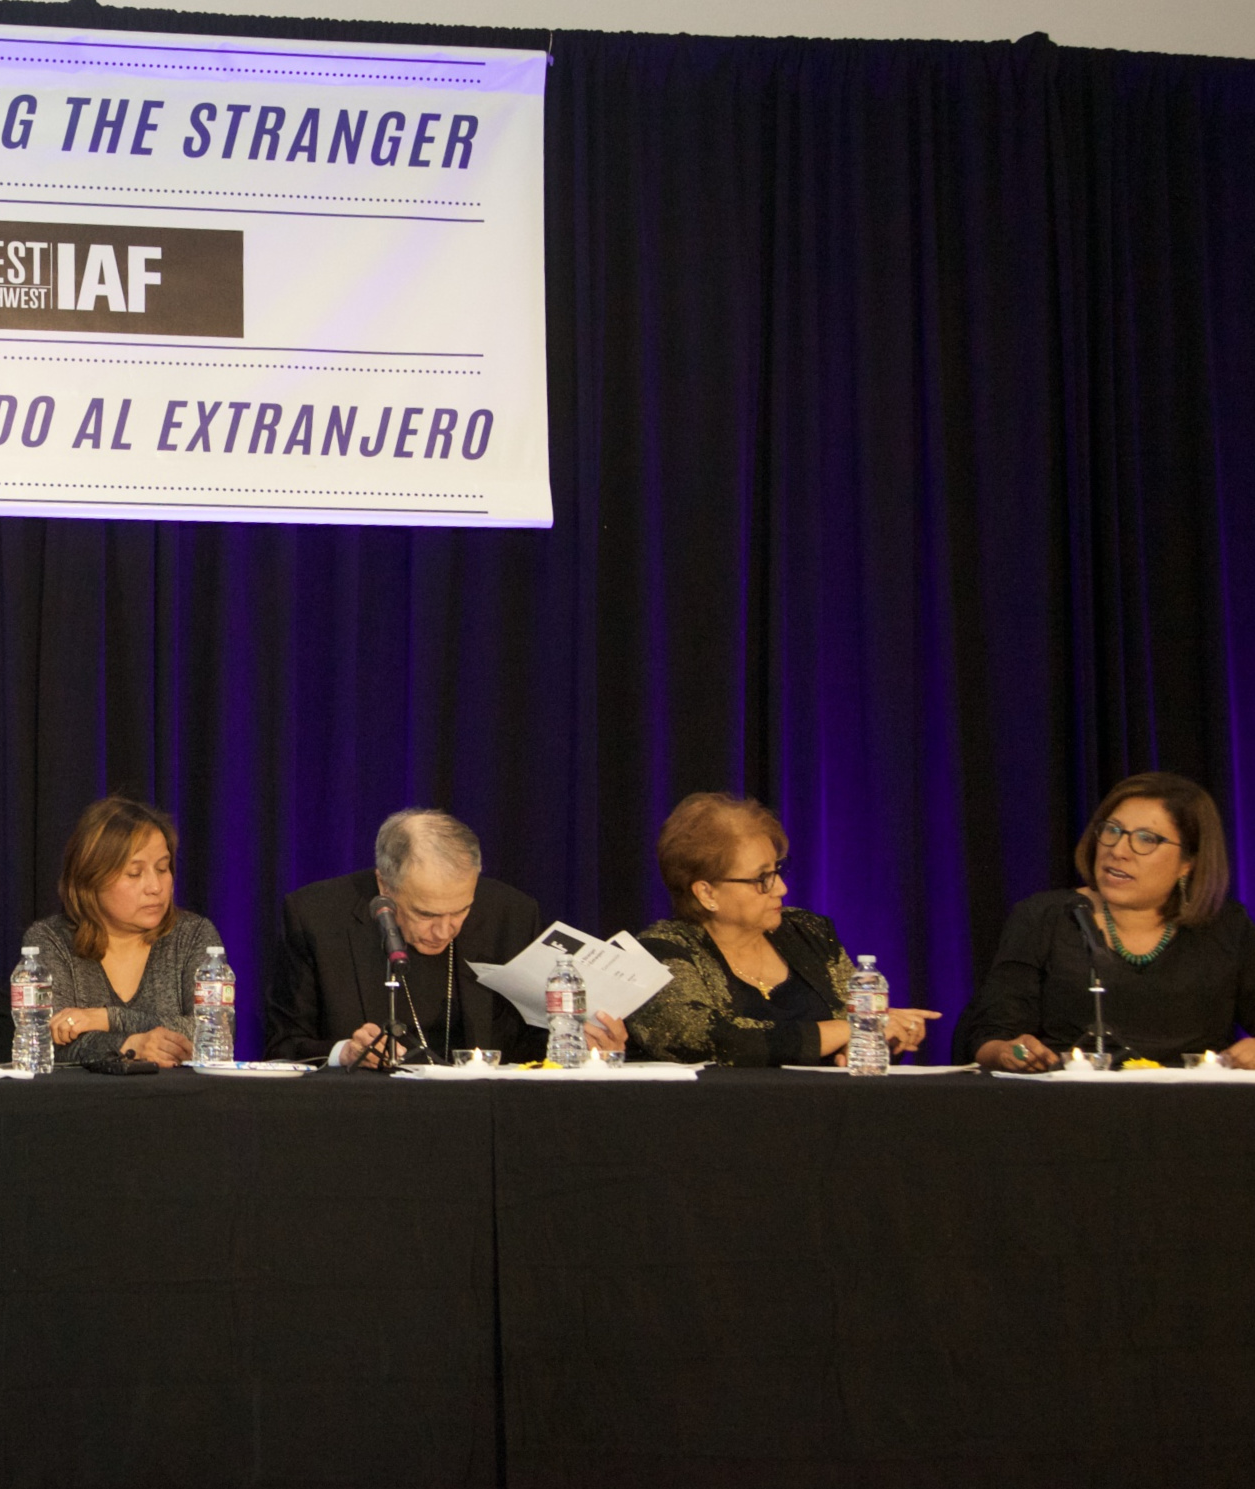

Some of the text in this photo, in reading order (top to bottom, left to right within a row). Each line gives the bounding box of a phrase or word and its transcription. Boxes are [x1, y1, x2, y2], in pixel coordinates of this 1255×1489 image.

[61, 96, 165, 156] THE
[182, 102, 479, 170] STRANGER
[57, 242, 163, 314] IAF
[71, 397, 133, 451] AL
[156, 399, 494, 461] EXTRANJERO
